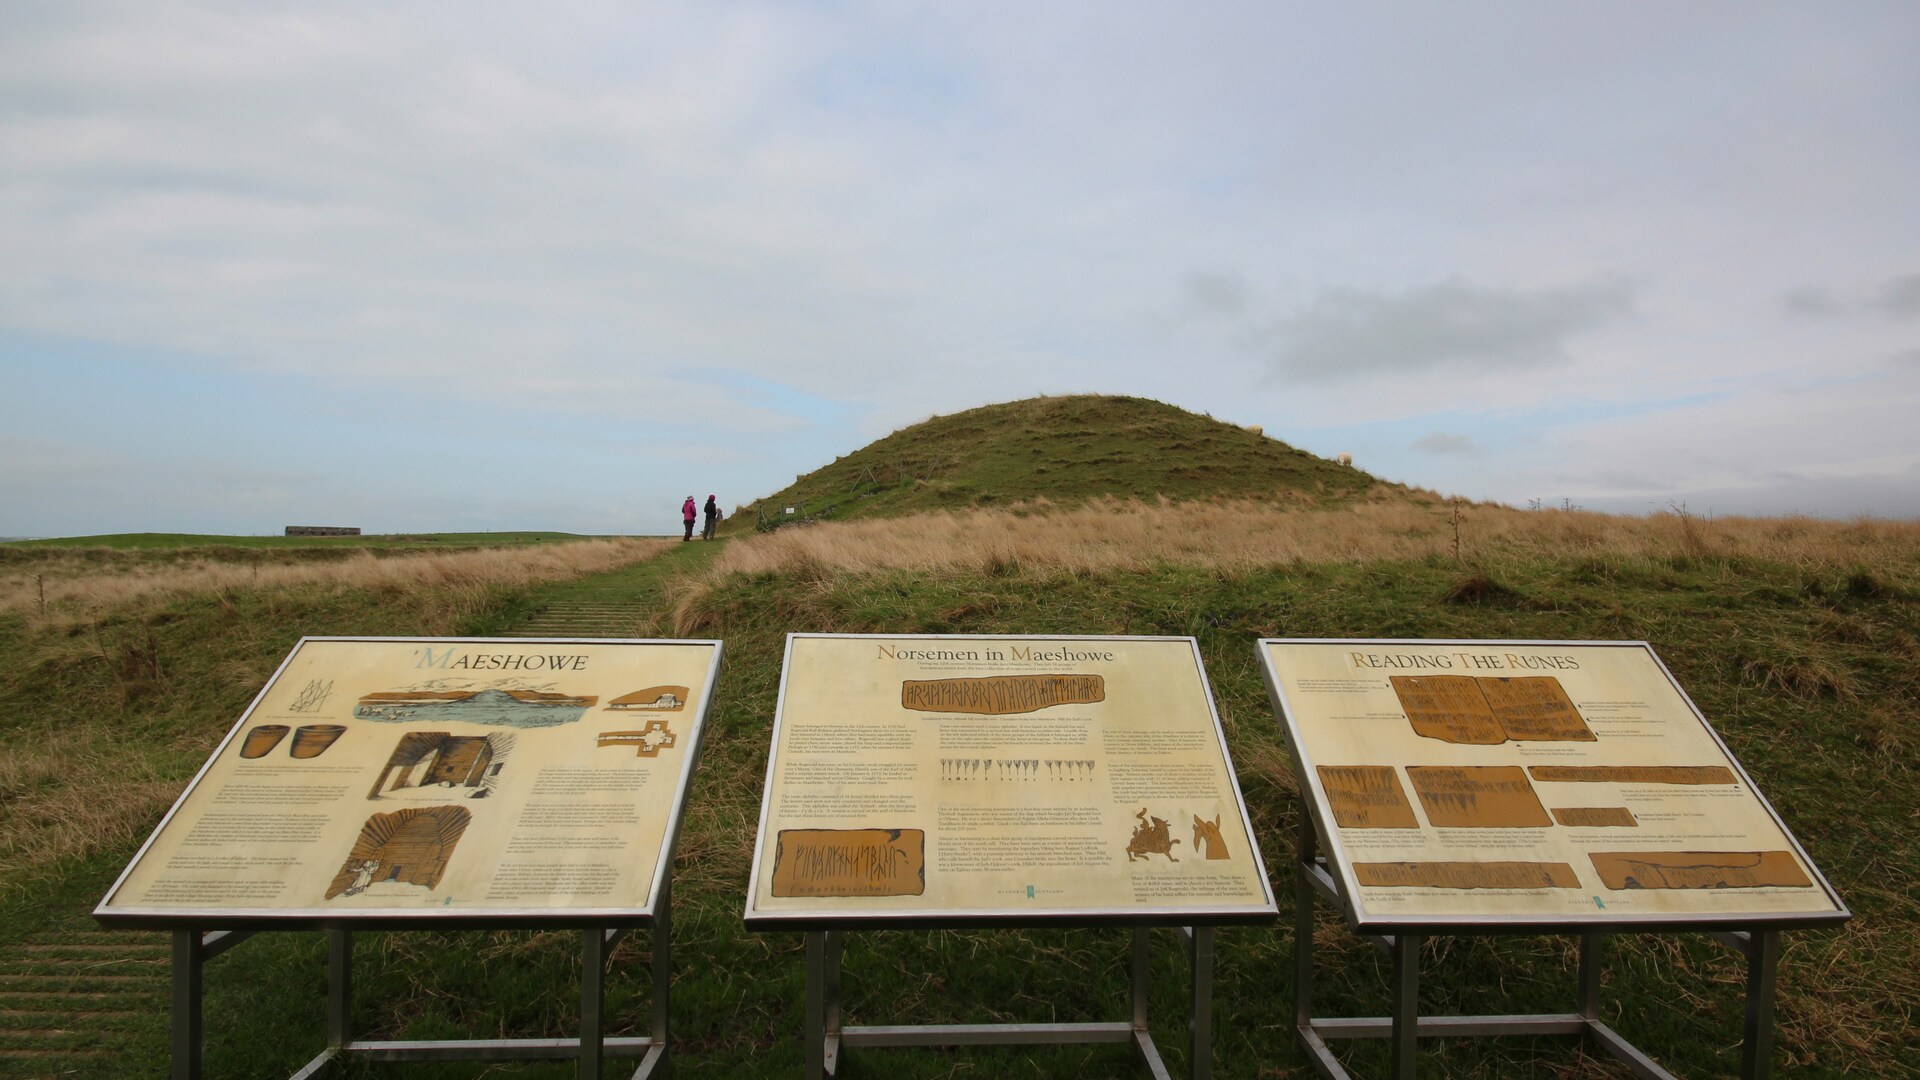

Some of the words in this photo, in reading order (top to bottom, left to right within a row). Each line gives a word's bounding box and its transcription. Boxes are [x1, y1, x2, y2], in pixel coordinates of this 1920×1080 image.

[877, 645, 979, 661] Norsemen
[985, 647, 1005, 661] in
[1010, 646, 1114, 662] Maeshowe
[1350, 652, 1453, 669] READING
[1453, 653, 1504, 669] THE
[1504, 653, 1580, 670] RUNES
